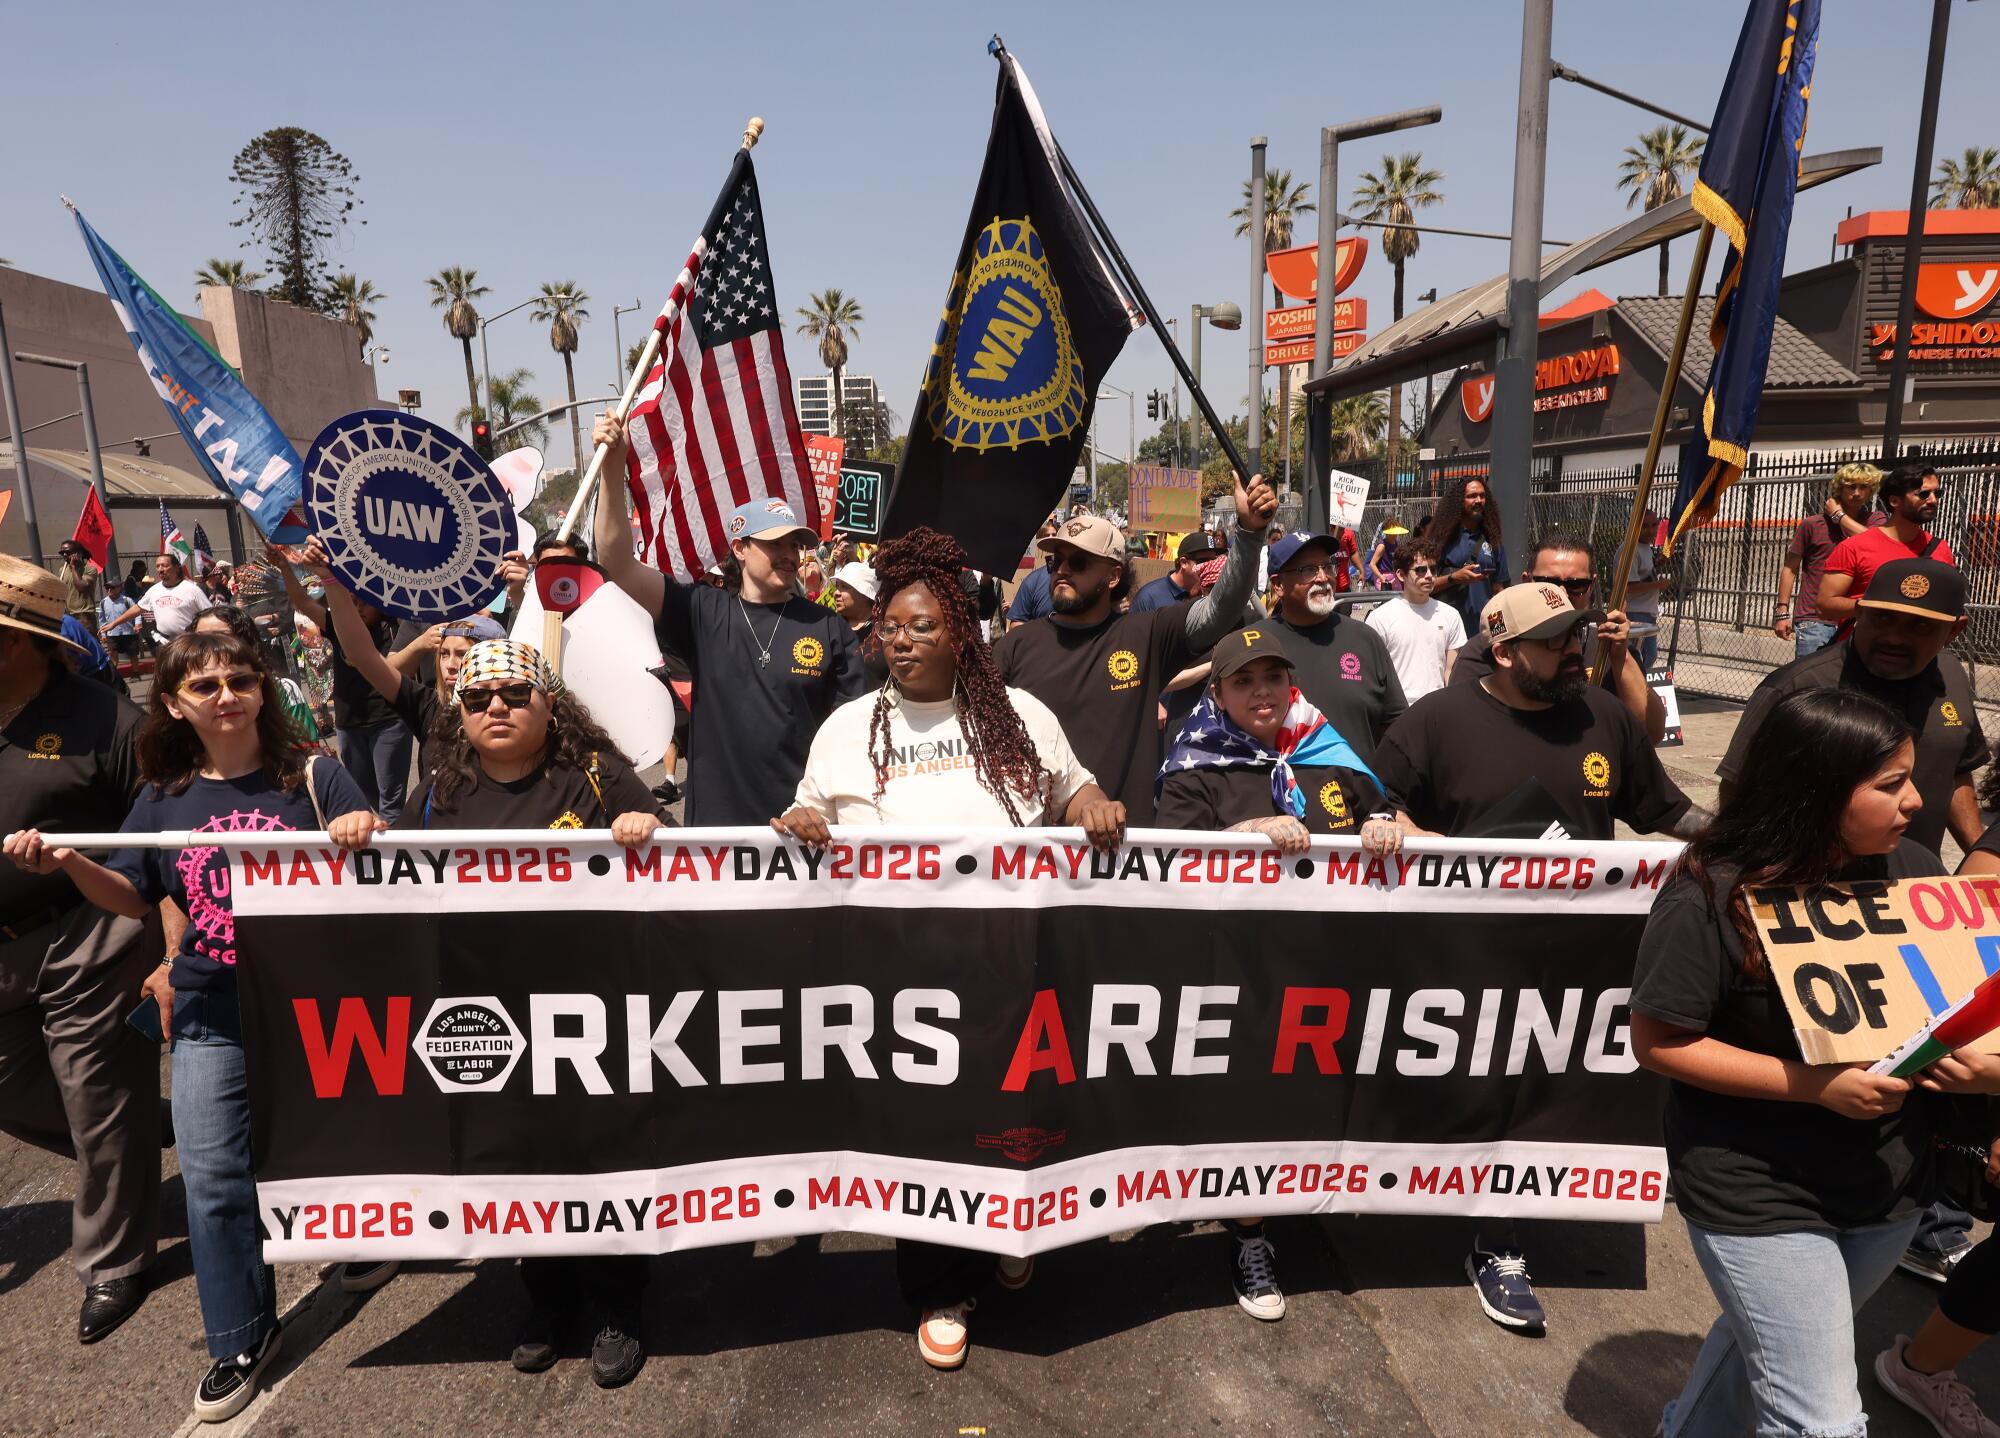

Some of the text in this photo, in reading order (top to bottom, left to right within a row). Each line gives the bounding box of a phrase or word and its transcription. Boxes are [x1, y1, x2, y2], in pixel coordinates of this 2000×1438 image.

[1274, 323, 1313, 336] JAPANESE
[338, 472, 355, 507] WORKERS
[352, 464, 362, 475] OF
[363, 453, 400, 467] AMERICA
[402, 455, 435, 476] UNITED
[363, 495, 445, 544] UAW
[369, 558, 433, 586] AGRICULTURAL
[434, 573, 454, 585] AND
[451, 530, 474, 576] AEROSPACE
[1242, 630, 1261, 647] P
[240, 847, 572, 886] MAYDAY2026
[626, 844, 940, 882] MAYDAY2026
[991, 845, 1281, 884] MAYDAY2026
[1326, 851, 1596, 890] MAYDAY2026
[1754, 881, 1907, 944] ICE
[437, 1010, 501, 1032] LOS ANGELES
[1793, 962, 1888, 1035] OF
[426, 1040, 513, 1053] FEDERATION
[451, 1024, 485, 1033] COUNTY
[1001, 984, 1241, 1092] ARE
[1271, 986, 1641, 1078] RISING
[457, 1059, 493, 1069] LABOR
[463, 1183, 761, 1237] MAYDAY2026
[808, 1176, 1079, 1232] MAYDAY2026
[1117, 1162, 1369, 1208] MAYDAY2026
[1408, 1164, 1662, 1202] MAYDAY2026
